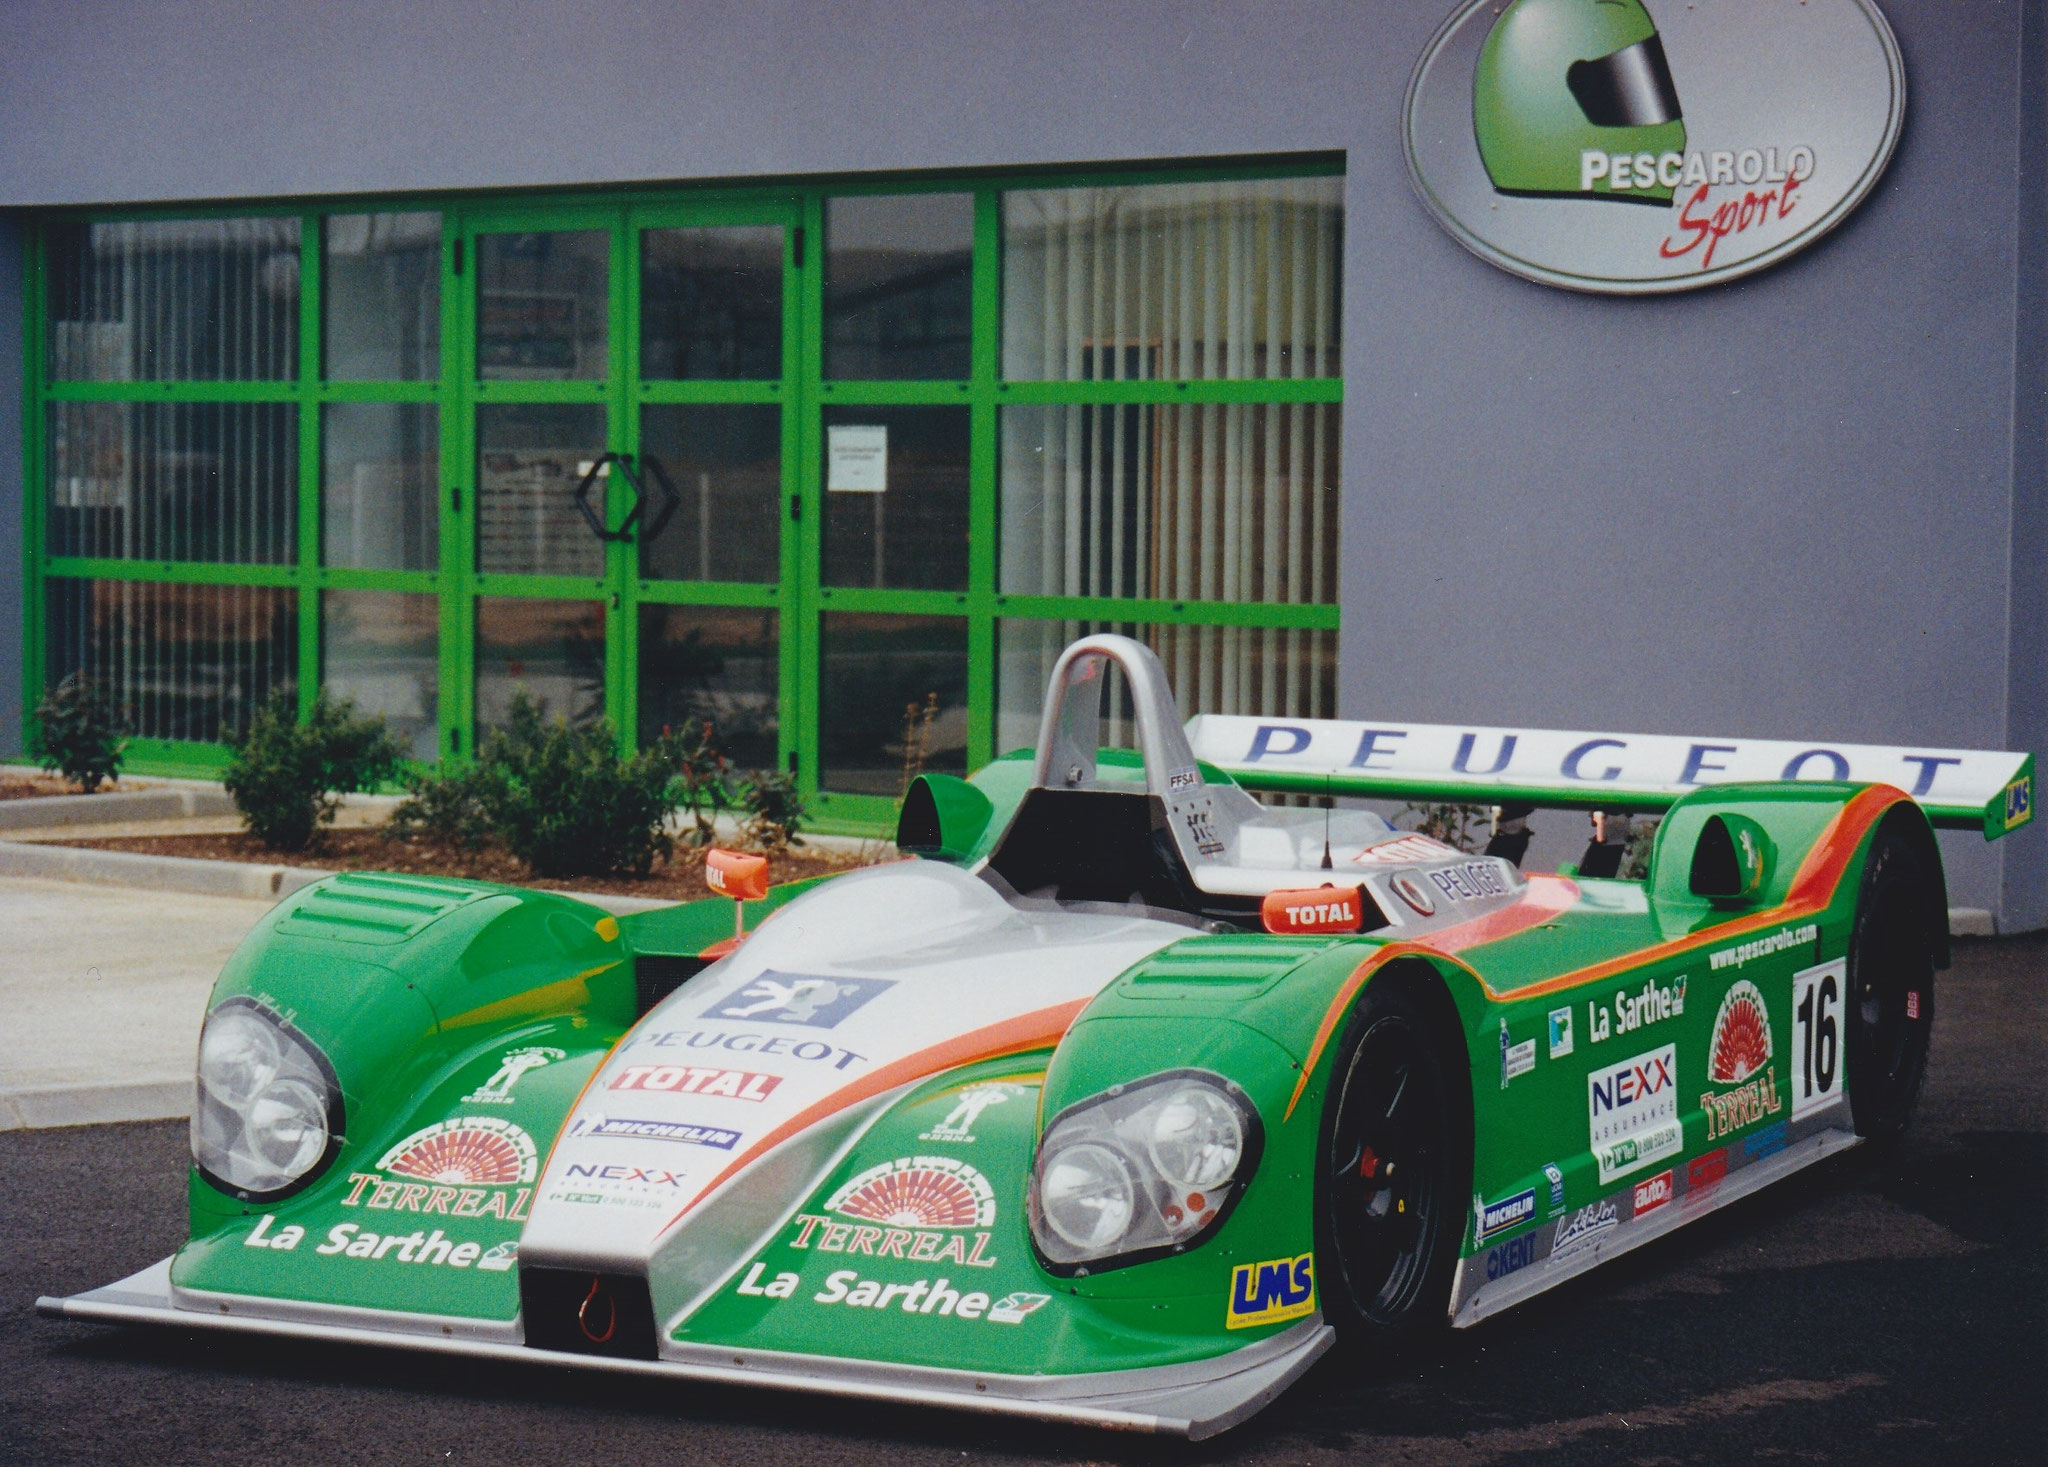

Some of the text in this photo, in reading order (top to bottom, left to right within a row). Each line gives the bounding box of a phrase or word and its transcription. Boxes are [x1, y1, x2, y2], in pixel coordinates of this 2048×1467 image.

[1581, 145, 1815, 191] PESCAROLO
[1659, 168, 1801, 268] Sport
[1170, 772, 1194, 788] FFSA
[1244, 725, 1962, 797] PEUGEOT
[1285, 902, 1354, 925] TOTAL
[1709, 924, 1818, 969] www.pescarolo.com
[1589, 978, 1671, 1043] La Sarthe
[621, 1029, 868, 1071] PEUGEOT
[1798, 975, 1838, 1098] 16
[616, 1065, 774, 1101] TOTAL
[1592, 1053, 1673, 1117] NEXX
[1701, 1066, 1781, 1141] TERREAL
[602, 1119, 738, 1146] MICHELIN
[341, 1172, 532, 1221] TERREAL
[566, 1164, 687, 1187] NEXX
[1635, 1179, 1665, 1209] auto
[1486, 1196, 1533, 1228] MICHELIN
[243, 1213, 480, 1268] La Sarthe
[789, 1213, 997, 1267] TERREAL
[1500, 1231, 1536, 1277] KENT
[736, 1261, 990, 1318] La Sarthe
[1232, 1257, 1312, 1315] LMS
